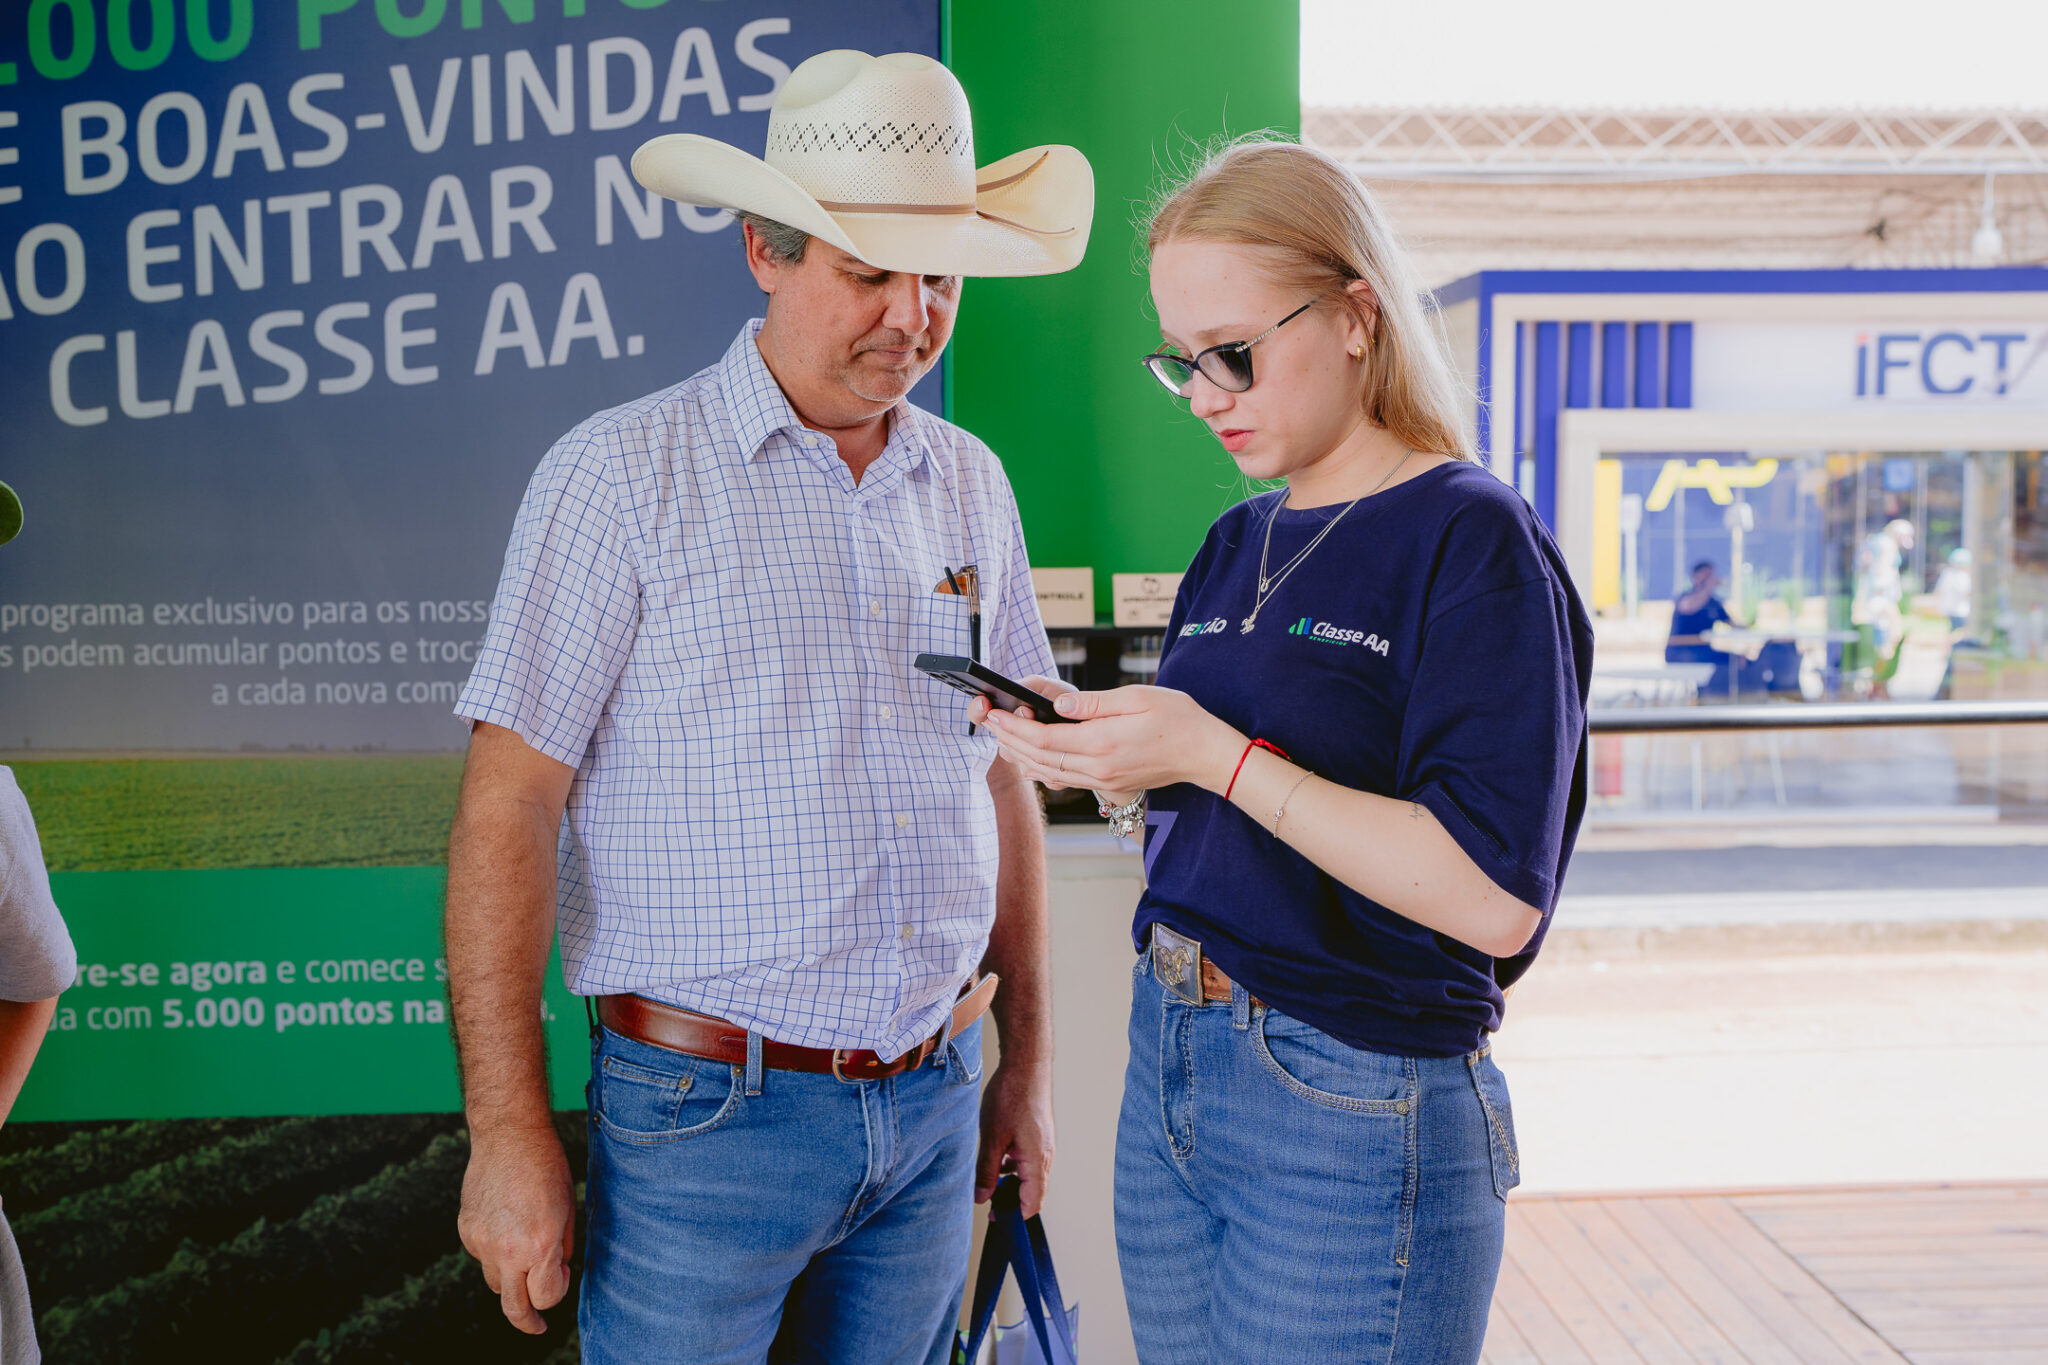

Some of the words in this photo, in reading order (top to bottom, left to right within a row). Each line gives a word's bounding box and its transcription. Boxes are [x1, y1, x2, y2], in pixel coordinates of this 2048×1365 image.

[61, 17, 793, 196] BOAS-VINDAS
[0, 222, 87, 320] O
[126, 165, 556, 304] ENTRAR
[49, 293, 439, 426] CLASSE
[474, 272, 645, 375] AA.
[1, 603, 145, 633] programa
[153, 596, 295, 625] exclusivo
[303, 600, 368, 630] para
[376, 600, 411, 623] os
[23, 638, 125, 673] podem
[133, 636, 270, 666] acumular
[278, 638, 381, 671] pontos
[390, 640, 408, 663] e
[1312, 621, 1364, 643] Classe
[1362, 633, 1390, 657] AA
[212, 683, 229, 705] a
[237, 677, 306, 705] cada
[316, 681, 388, 704] nova
[170, 960, 267, 992] agora
[277, 960, 296, 983] e
[305, 958, 426, 983] comece
[87, 1005, 152, 1030] com
[162, 997, 265, 1029] 5.000
[275, 998, 394, 1033] pontos
[403, 999, 445, 1024] na
